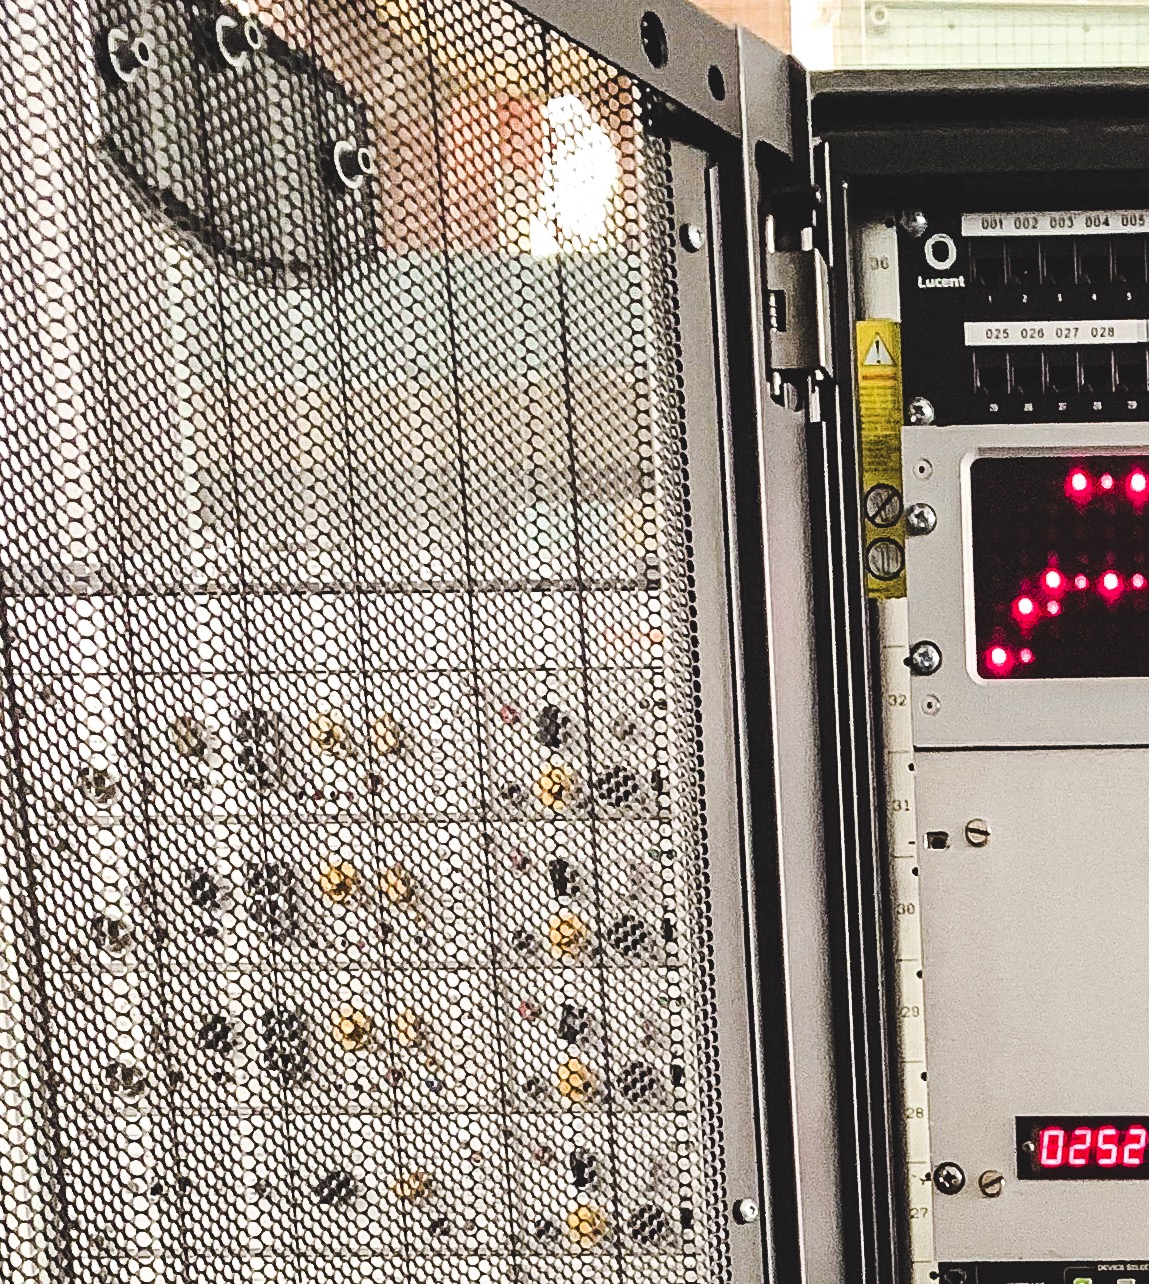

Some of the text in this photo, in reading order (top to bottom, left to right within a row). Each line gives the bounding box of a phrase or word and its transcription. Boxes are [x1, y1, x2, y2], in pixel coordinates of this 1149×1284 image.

[981, 217, 1004, 230] 001
[1014, 217, 1038, 230] 002
[1050, 217, 1074, 229] 003
[1085, 216, 1110, 228] 004
[1121, 215, 1145, 227] 005
[917, 275, 966, 289] Lucent
[986, 326, 1115, 339] 025 026 027 028
[889, 694, 907, 706] 32
[893, 800, 910, 811] 31
[897, 903, 915, 915] 30
[901, 1006, 919, 1018] 29
[906, 1107, 924, 1119] 28
[1040, 1128, 1148, 1168] 0252
[910, 1208, 928, 1219] 27
